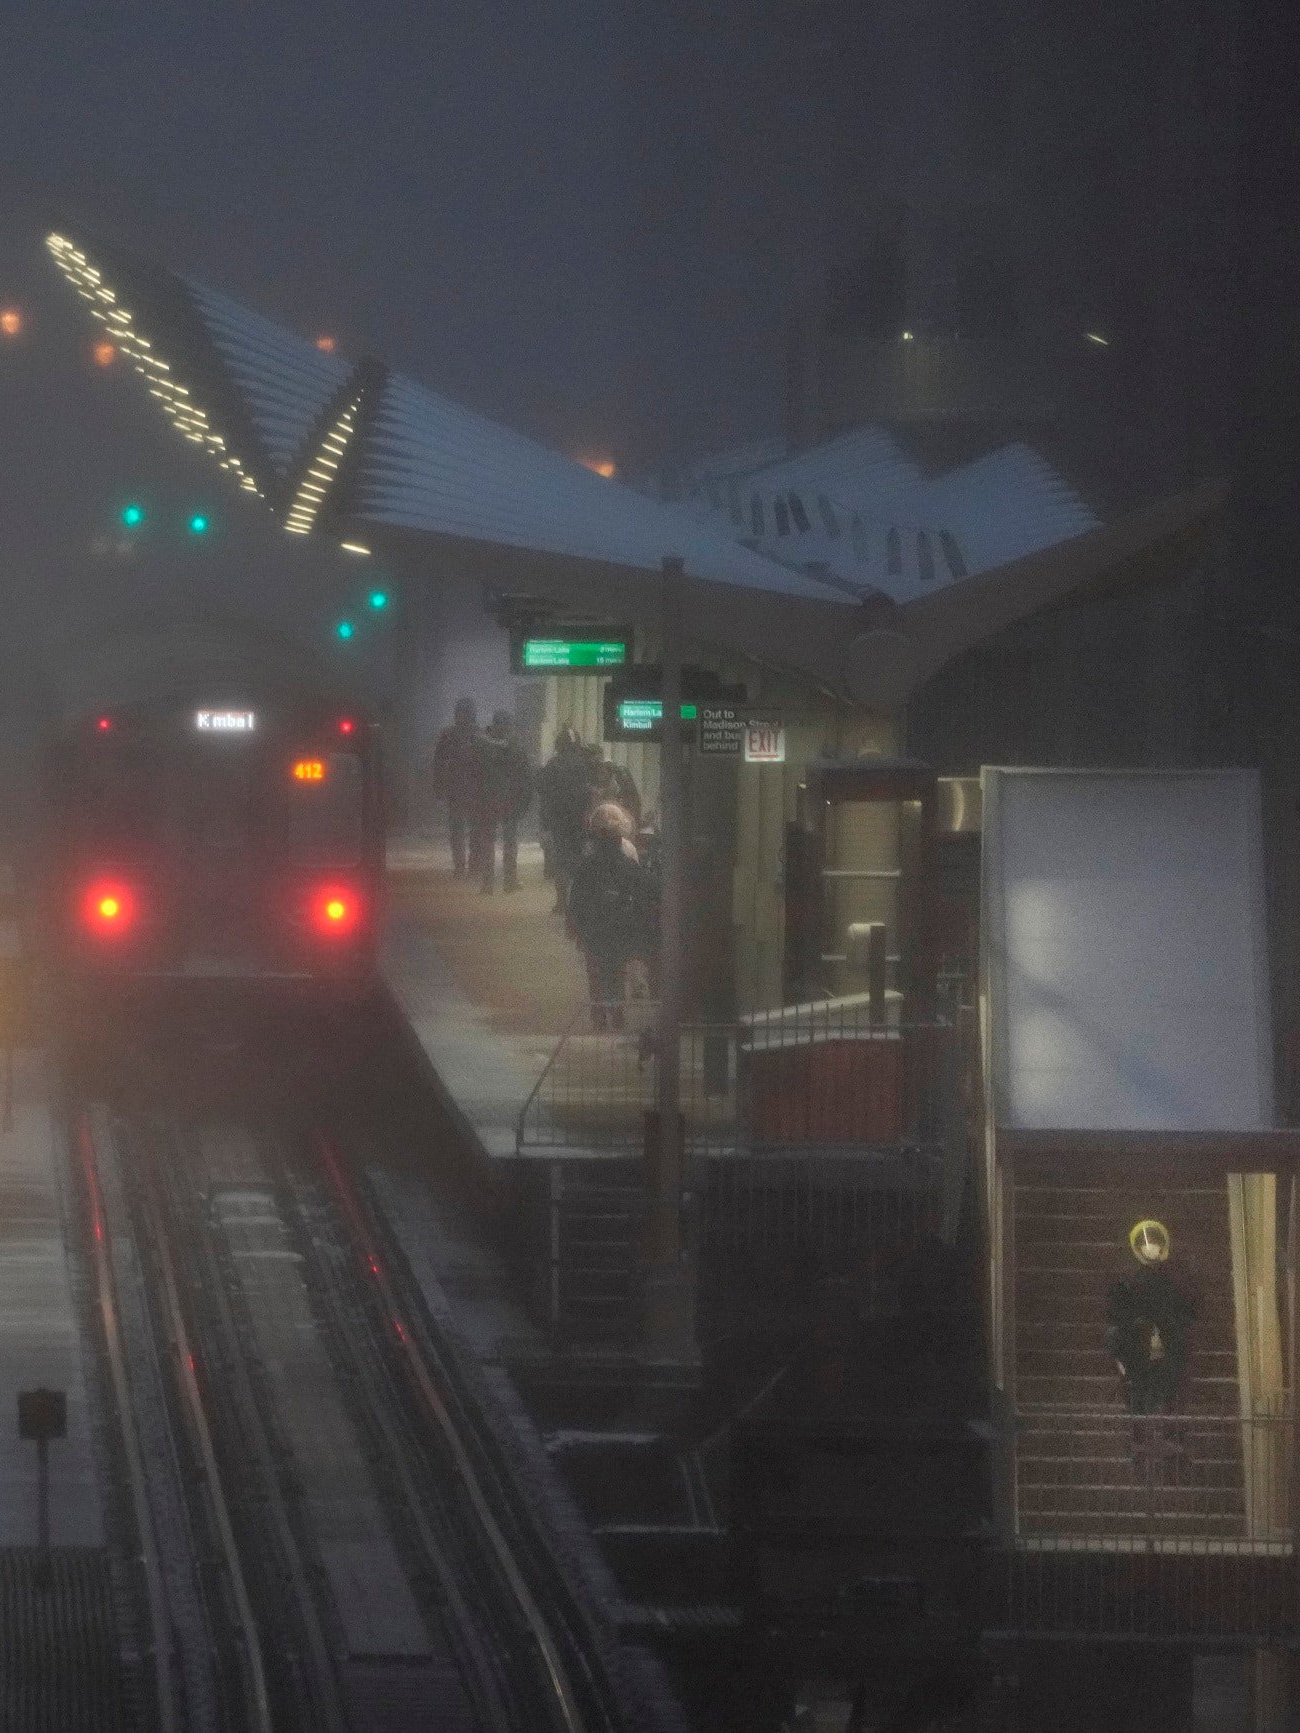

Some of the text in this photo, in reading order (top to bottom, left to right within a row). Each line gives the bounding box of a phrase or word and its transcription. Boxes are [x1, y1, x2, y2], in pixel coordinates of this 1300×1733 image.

[703, 710, 735, 719] Out to
[749, 729, 780, 752] EXIT
[295, 762, 323, 779] 412
